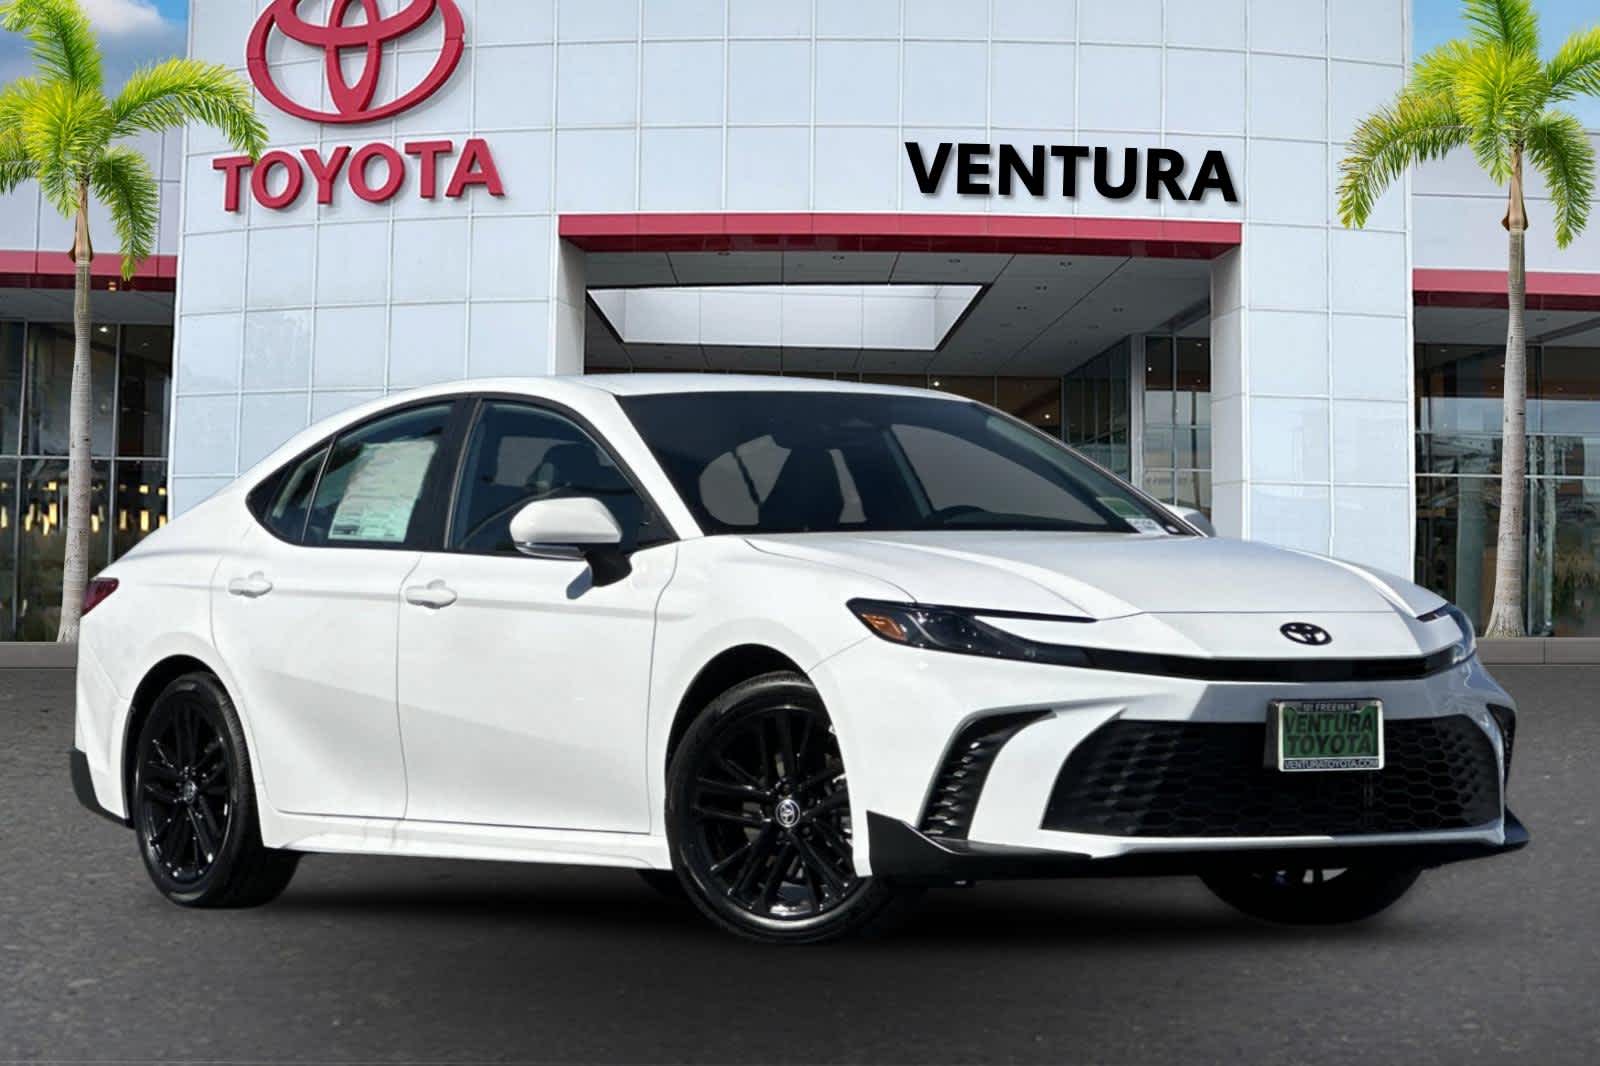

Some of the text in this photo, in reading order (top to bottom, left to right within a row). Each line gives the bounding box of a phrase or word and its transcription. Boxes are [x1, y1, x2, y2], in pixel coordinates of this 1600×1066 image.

[212, 138, 505, 213] TOYOTA
[904, 142, 1239, 203] VENTURA
[1315, 703, 1355, 712] FREEWAY
[1283, 712, 1374, 734] VENTURA
[1286, 734, 1372, 756] TOYOTA
